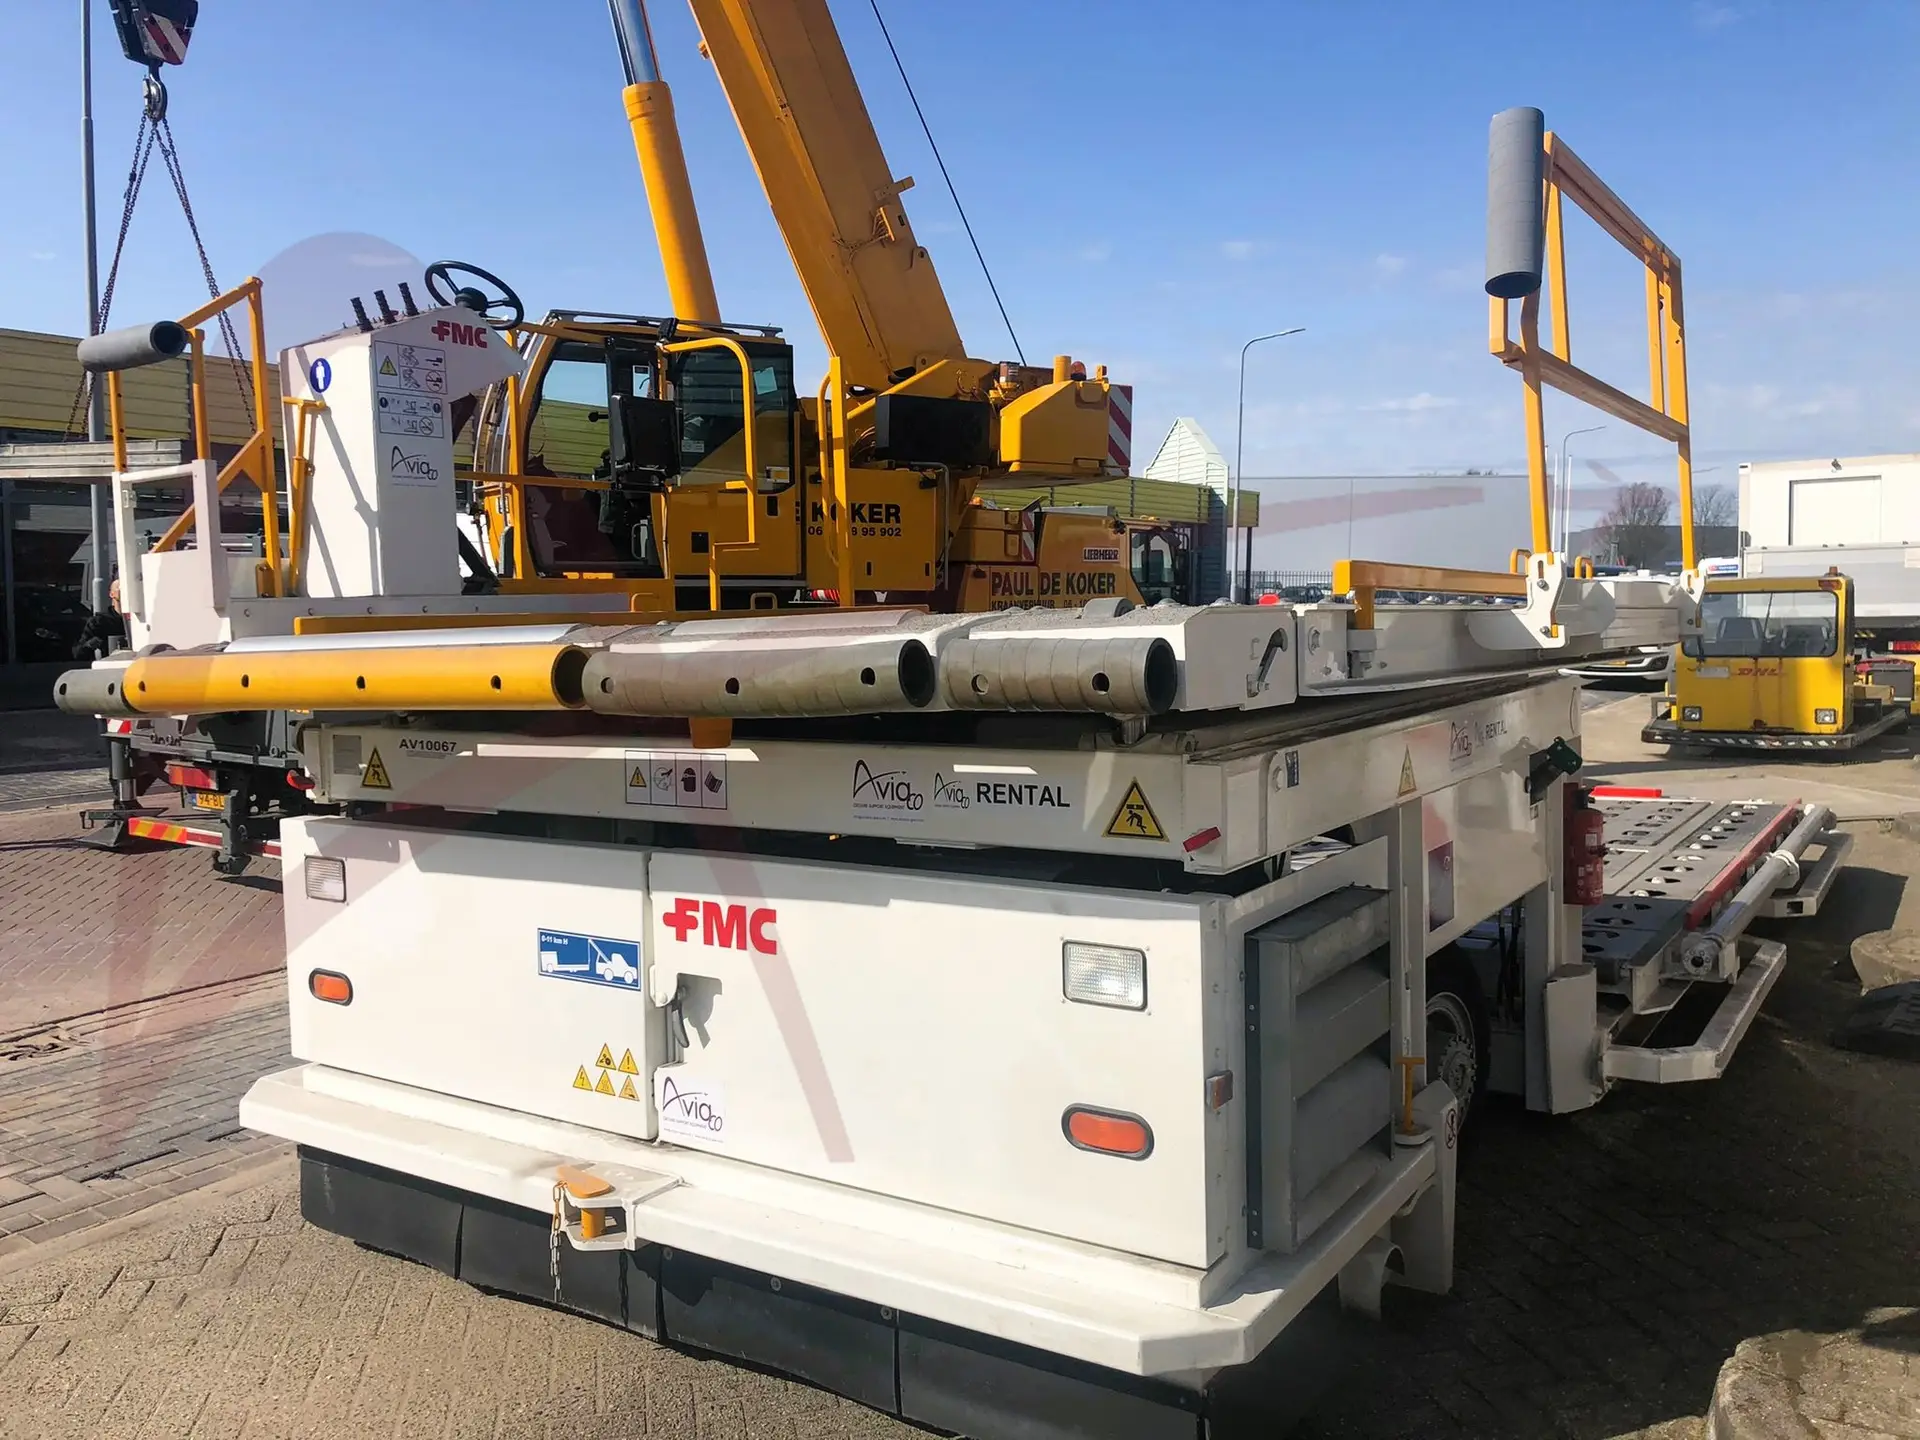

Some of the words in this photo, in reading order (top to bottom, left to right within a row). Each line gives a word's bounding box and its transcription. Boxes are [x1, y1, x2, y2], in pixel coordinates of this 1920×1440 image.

[431, 320, 488, 348] FMC
[861, 527, 876, 537] 95
[880, 527, 902, 537] 902
[1083, 548, 1119, 561] LIEBHERR
[991, 572, 1034, 596] PAUL
[1040, 572, 1060, 596] DE
[1066, 572, 1116, 595] KOKER
[399, 739, 457, 752] AV10067
[976, 782, 1071, 808] RENTAL
[663, 897, 777, 955] FMC
